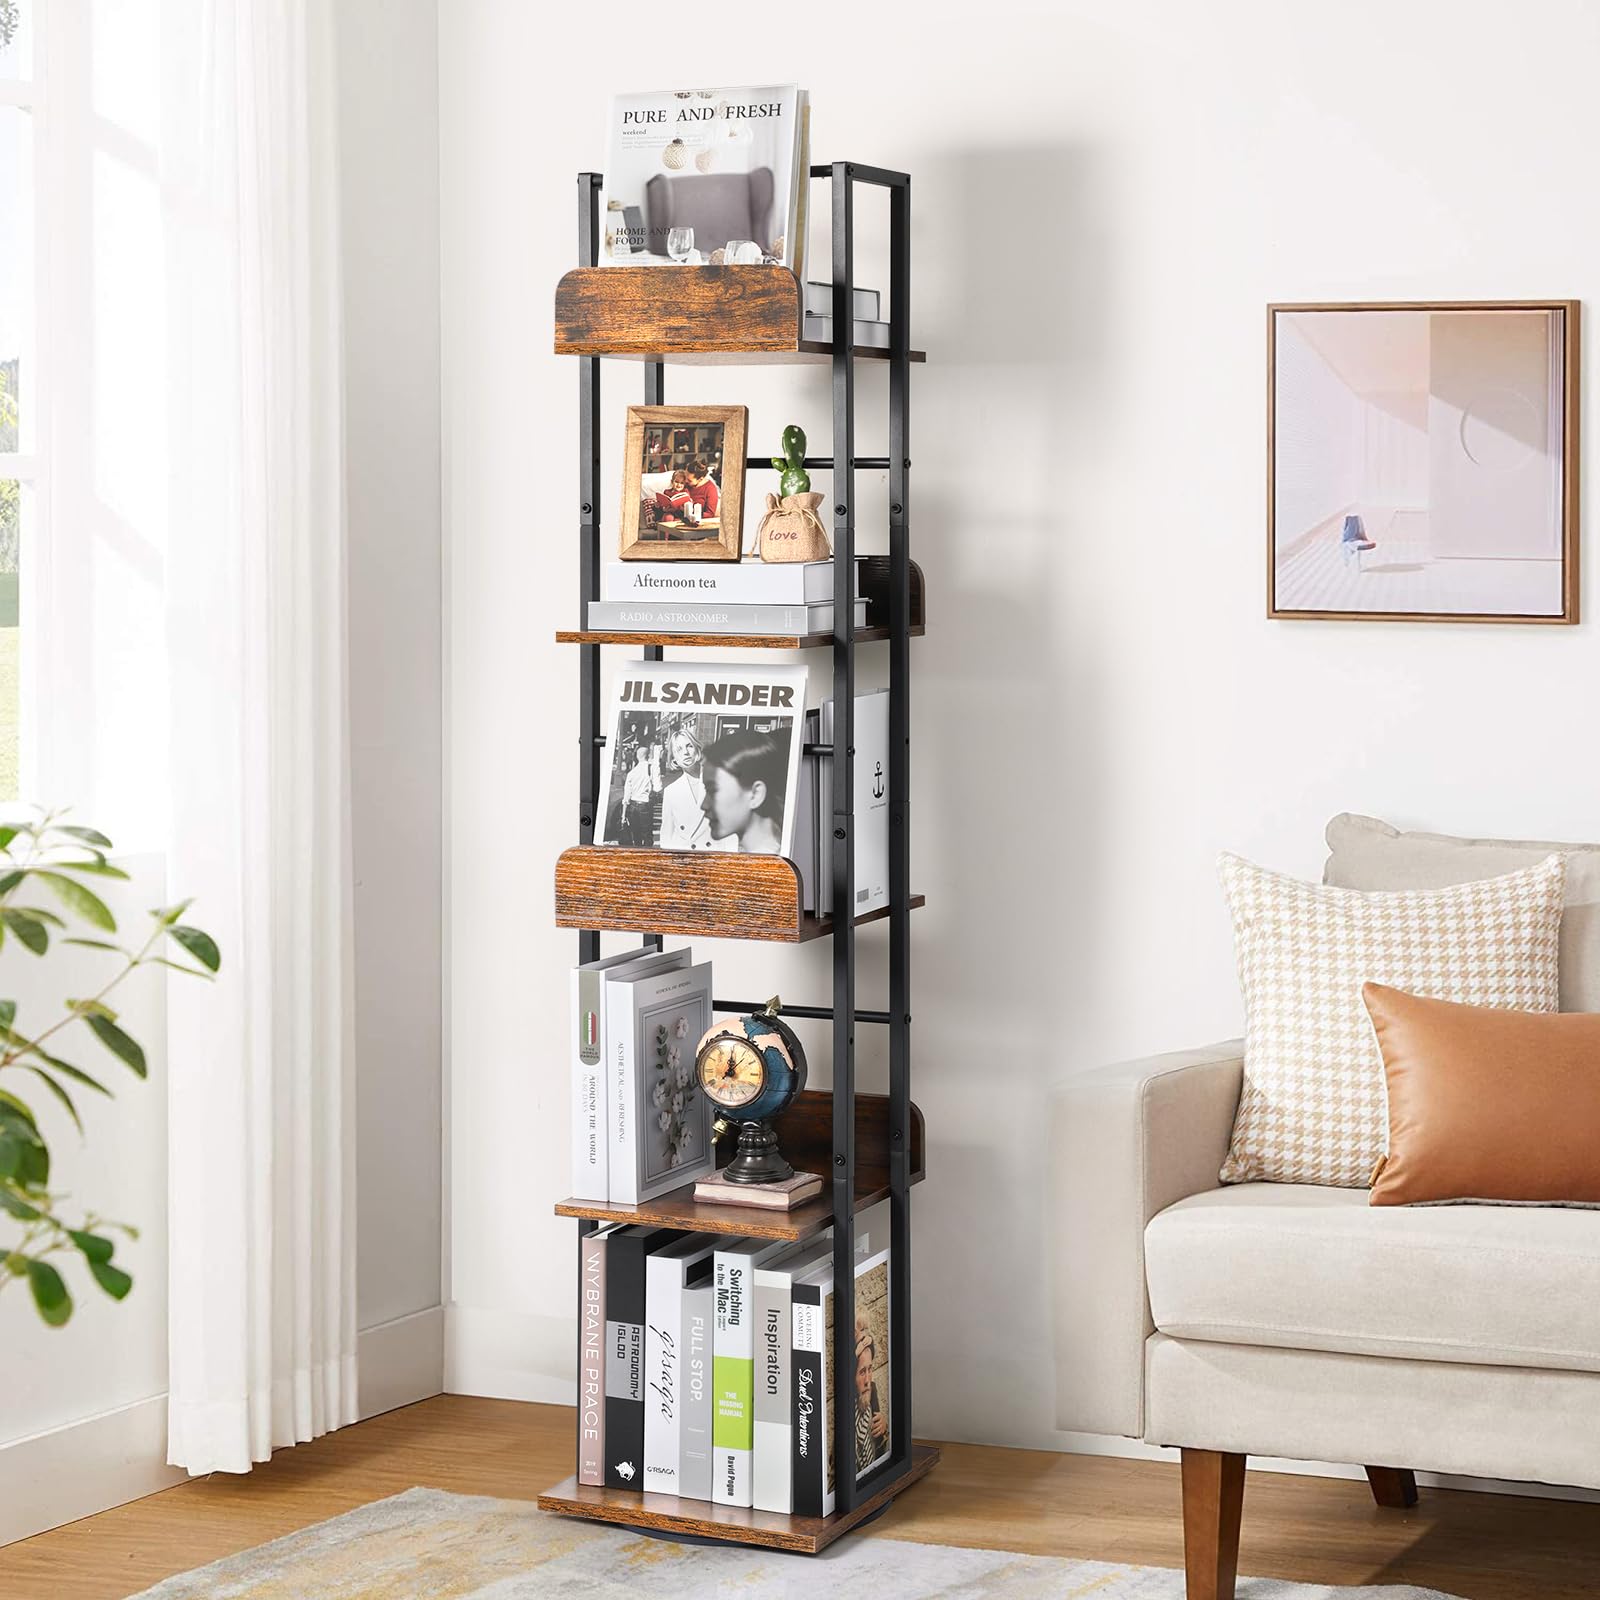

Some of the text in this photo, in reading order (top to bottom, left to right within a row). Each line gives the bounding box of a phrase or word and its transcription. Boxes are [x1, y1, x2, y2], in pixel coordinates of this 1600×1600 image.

[623, 103, 782, 124] PURE AND FRESH
[615, 237, 644, 245] FOOD
[616, 227, 670, 236] HOME AND
[769, 530, 798, 541] love
[633, 573, 716, 589] Afternoon tea
[620, 611, 729, 624] RADIO ASTRONOMER
[620, 681, 794, 708] JIL SANDER
[717, 1273, 725, 1286] the
[718, 1288, 729, 1313] Mac
[728, 1269, 743, 1325] Switching
[584, 1252, 601, 1440] WYBRANE PRACE
[617, 1325, 626, 1359] IGLOO
[691, 1316, 704, 1357] FULL
[630, 1327, 640, 1399] ASTRONOMY
[764, 1308, 781, 1395] Inspiration
[799, 1368, 813, 1400] Duel
[727, 1456, 735, 1496] David Pogue
